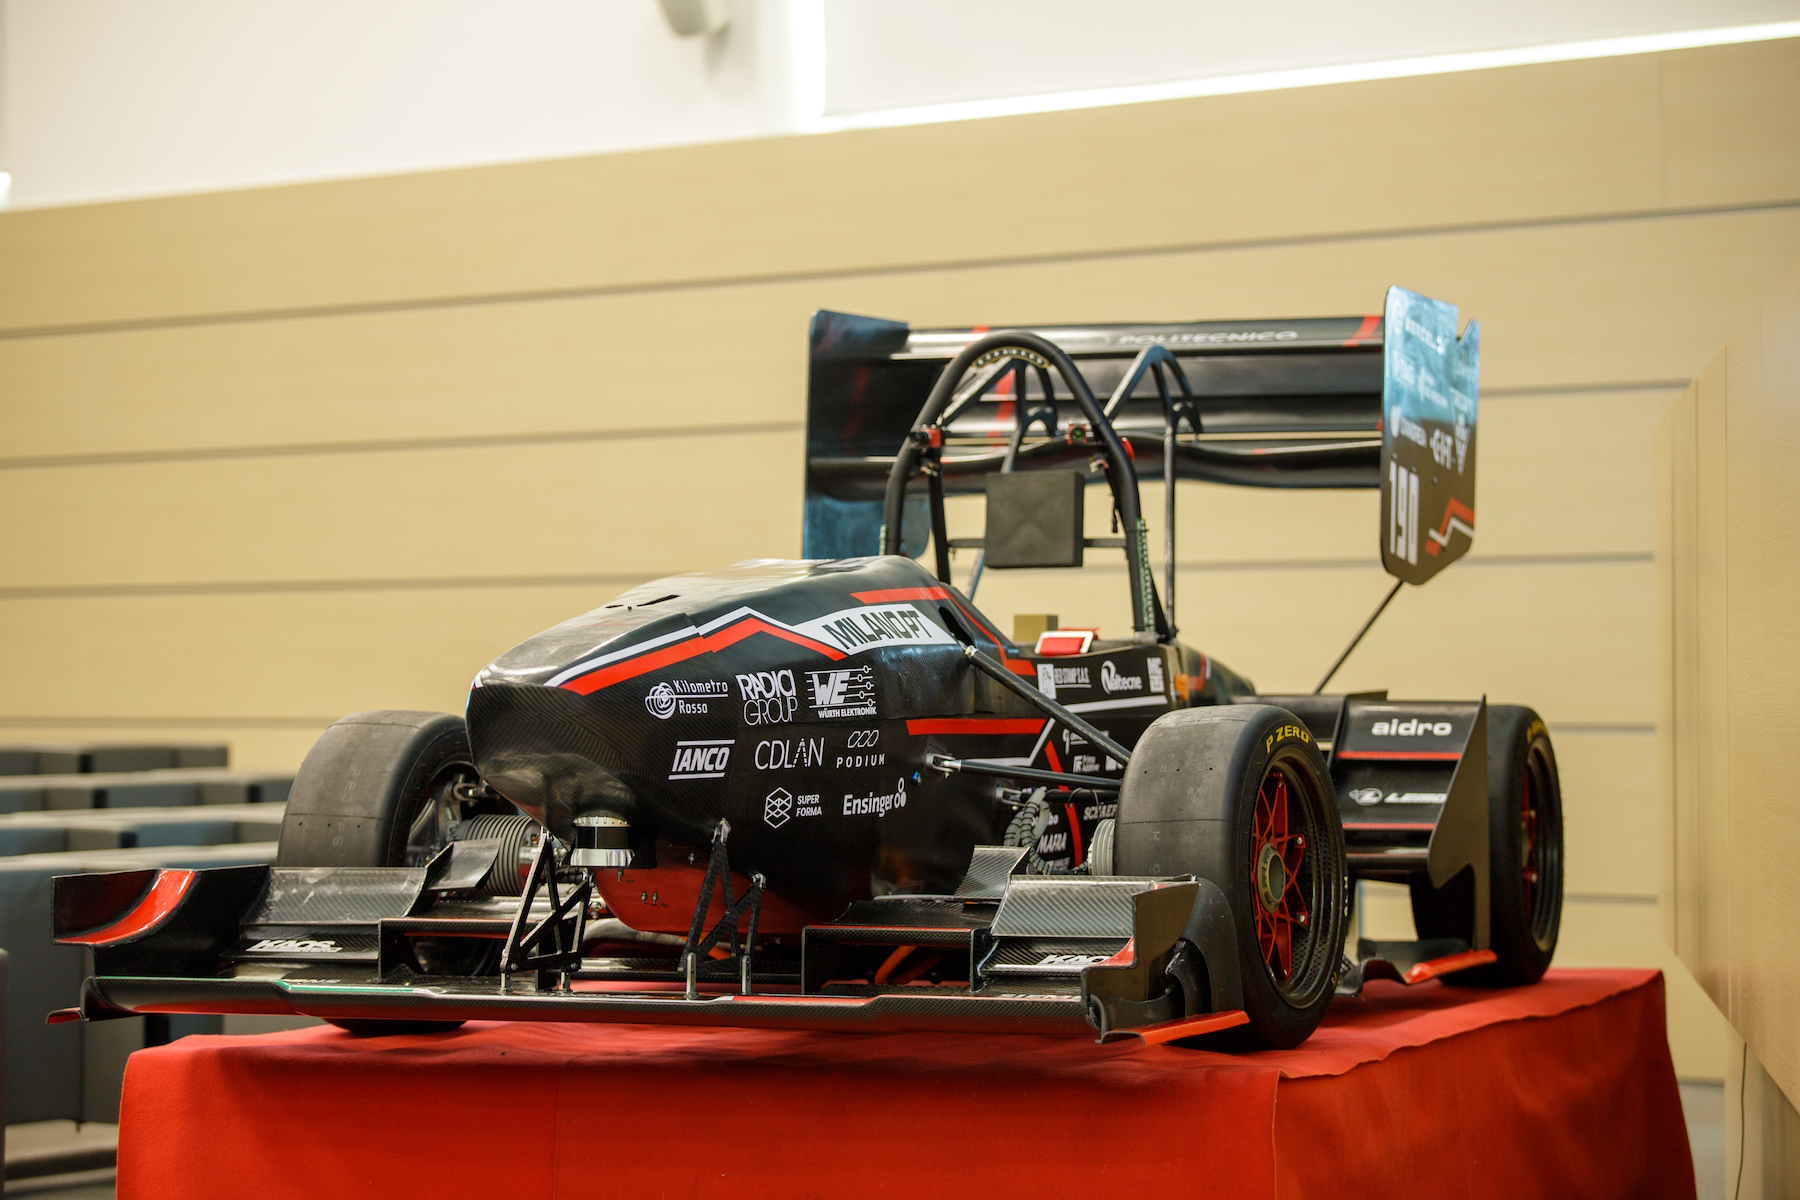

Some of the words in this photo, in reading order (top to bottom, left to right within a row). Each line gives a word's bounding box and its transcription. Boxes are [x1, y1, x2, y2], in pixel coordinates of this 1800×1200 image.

[1118, 330, 1298, 345] POLITECNICO
[1389, 459, 1420, 566] 190
[673, 679, 728, 693] Kilometro
[735, 669, 796, 700] RADICI
[811, 671, 850, 705] WE
[678, 700, 708, 714] Rosso
[743, 696, 798, 726] GROUP
[818, 708, 840, 719] WÜRTH
[840, 706, 877, 717] ELEKTRONIK
[1371, 718, 1453, 736] aidro
[1266, 734, 1274, 754] P
[1275, 725, 1310, 744] ZERO
[754, 737, 825, 770] CDLAN
[836, 753, 885, 769] PODIUM
[797, 794, 820, 805] SUPER
[843, 791, 893, 818] Ensinger
[796, 806, 822, 817] FORMA
